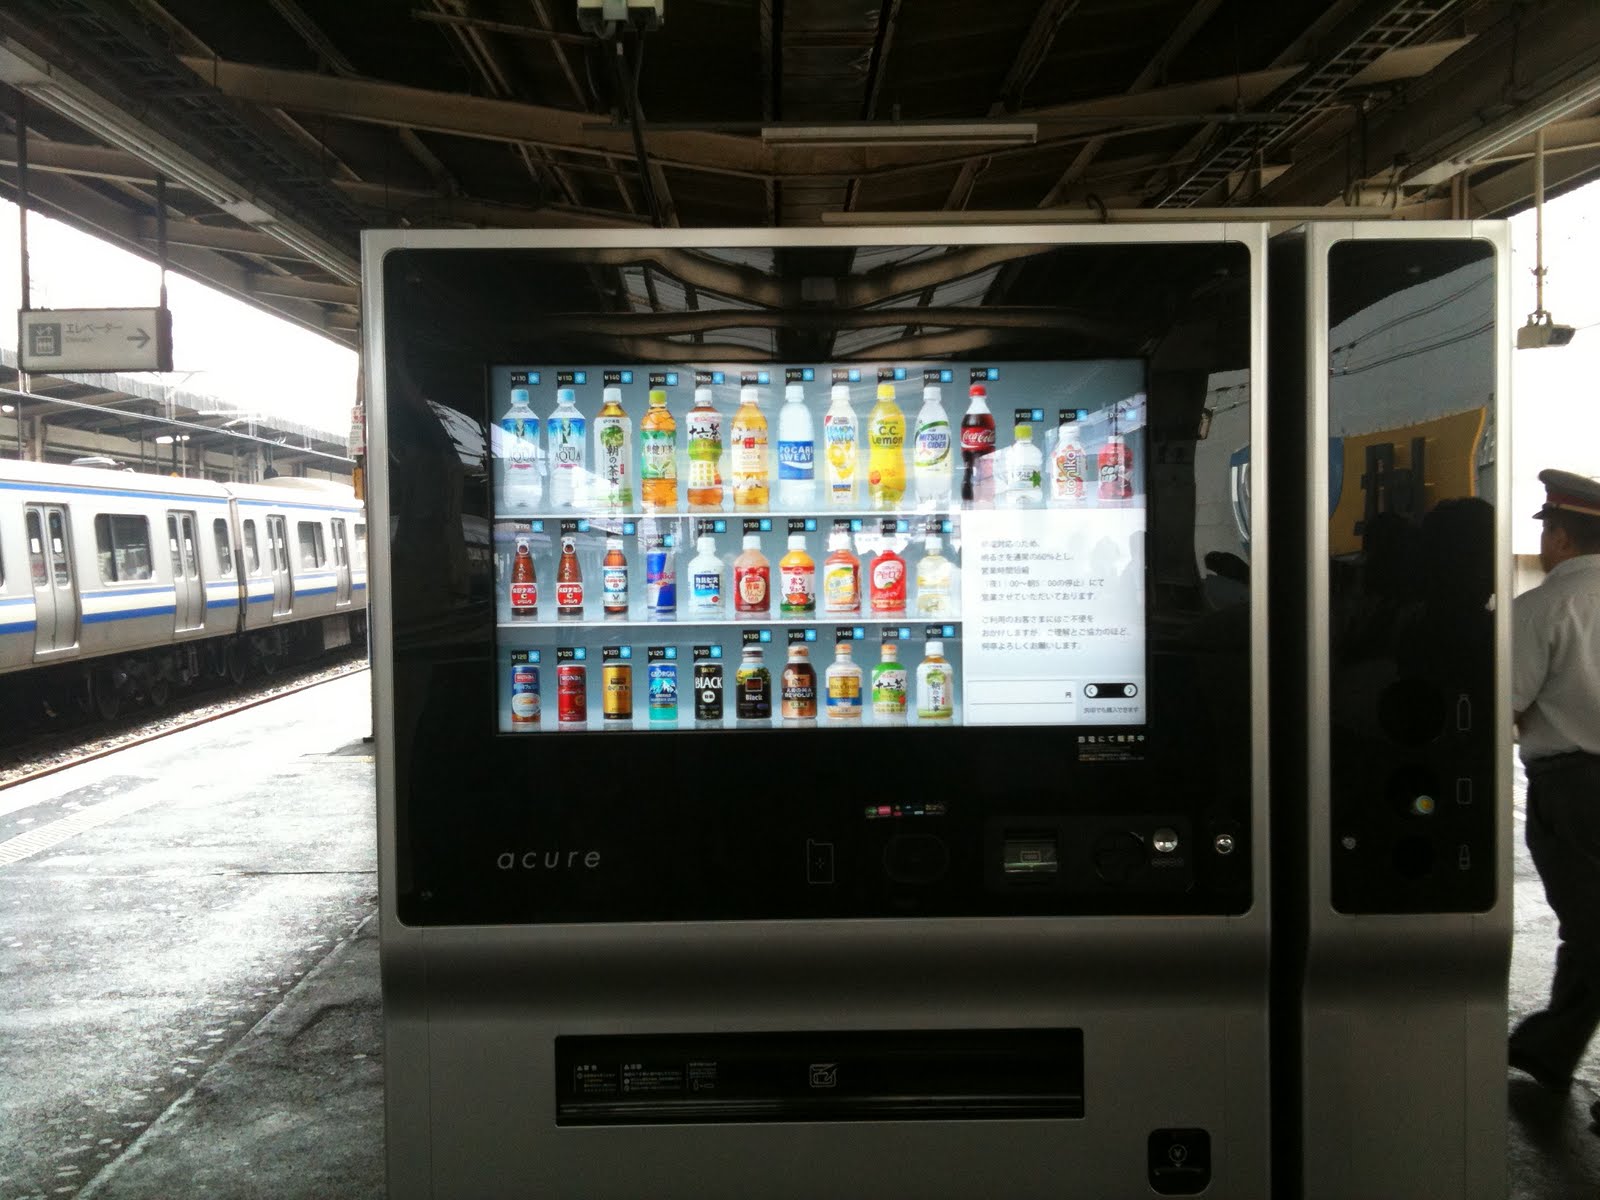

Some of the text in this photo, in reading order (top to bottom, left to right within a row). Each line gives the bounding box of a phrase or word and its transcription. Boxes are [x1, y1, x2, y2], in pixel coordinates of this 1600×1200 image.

[65, 322, 122, 334] エレベーター
[689, 423, 720, 442] 十六茶
[780, 445, 813, 453] POCARI
[780, 453, 812, 462] SWEAT
[695, 677, 722, 689] BLACK
[497, 851, 600, 869] acure
